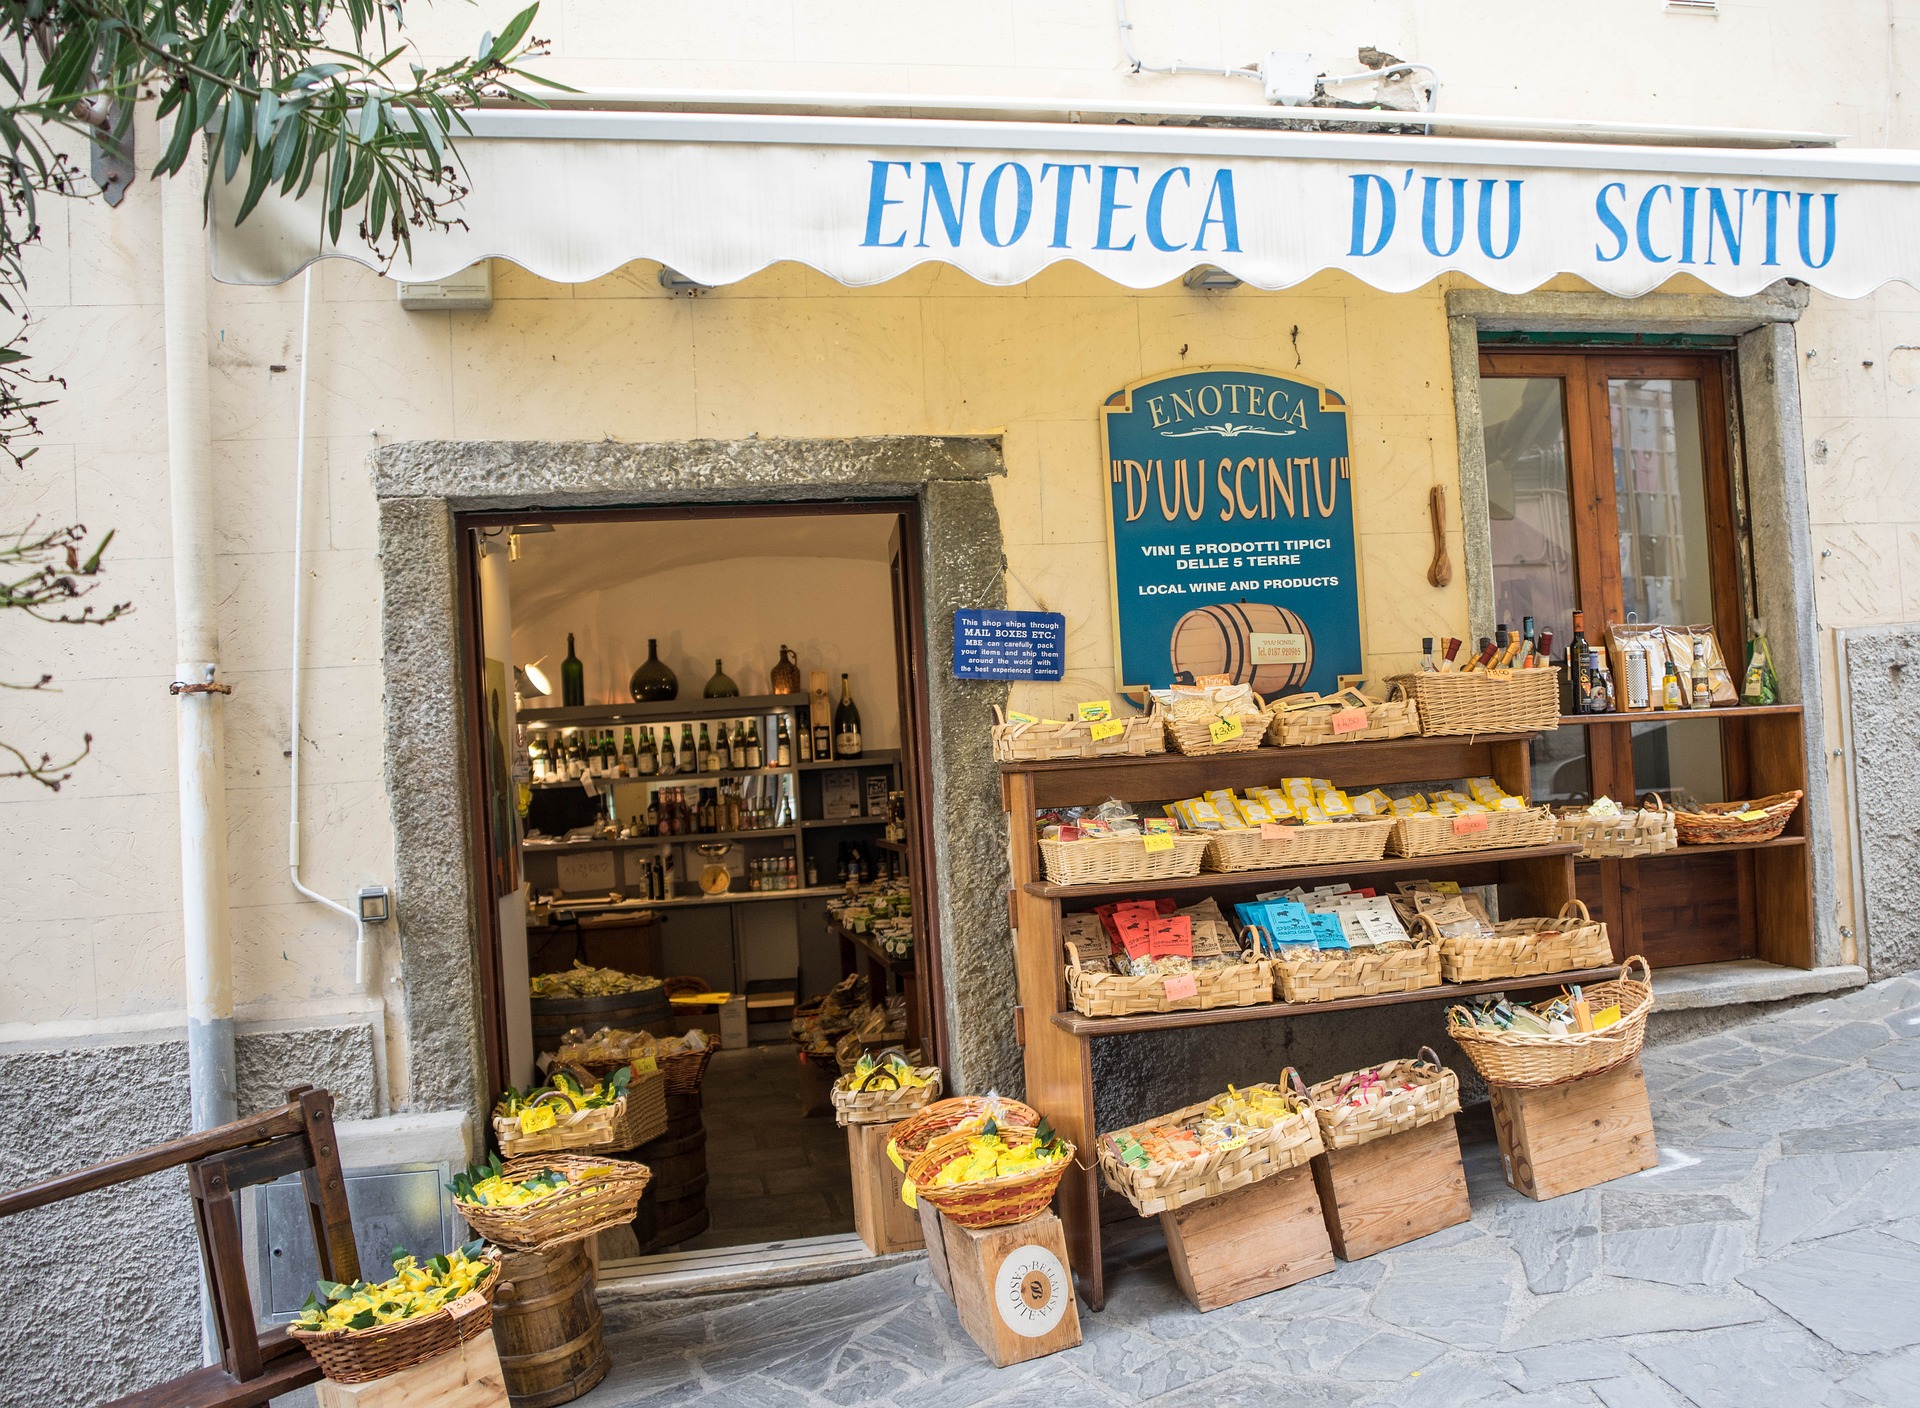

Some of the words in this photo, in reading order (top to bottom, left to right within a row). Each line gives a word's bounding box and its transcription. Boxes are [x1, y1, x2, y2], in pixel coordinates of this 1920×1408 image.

[858, 160, 1244, 253] ENOTECA
[1346, 168, 1524, 260] D'UU
[1595, 182, 1839, 269] SCINTU
[1146, 384, 1309, 430] ENOTECA
[1217, 456, 1350, 522] SCINTU"
[1141, 543, 1175, 557] VINI
[1180, 544, 1191, 556] E
[1195, 540, 1280, 555] PRODOTTI
[1283, 538, 1331, 551] TIPICI
[1176, 557, 1229, 570] DELLE
[1233, 557, 1243, 568] 5
[1246, 554, 1301, 567] TERRE
[1138, 584, 1187, 596] LOCAL
[1189, 581, 1227, 593] WINE
[1229, 579, 1260, 591] AND
[1263, 576, 1339, 590] PRODUCTS
[962, 618, 978, 626] This
[982, 619, 1001, 628] shop
[1005, 621, 1026, 629] ships
[1030, 621, 1059, 630] through
[964, 629, 991, 637] MAIL
[995, 630, 1028, 638] BOXES
[981, 648, 1001, 656] items
[1022, 650, 1037, 658] ship
[1004, 641, 1033, 649] carefully
[1032, 1260, 1059, 1317] BELLAVISTA
